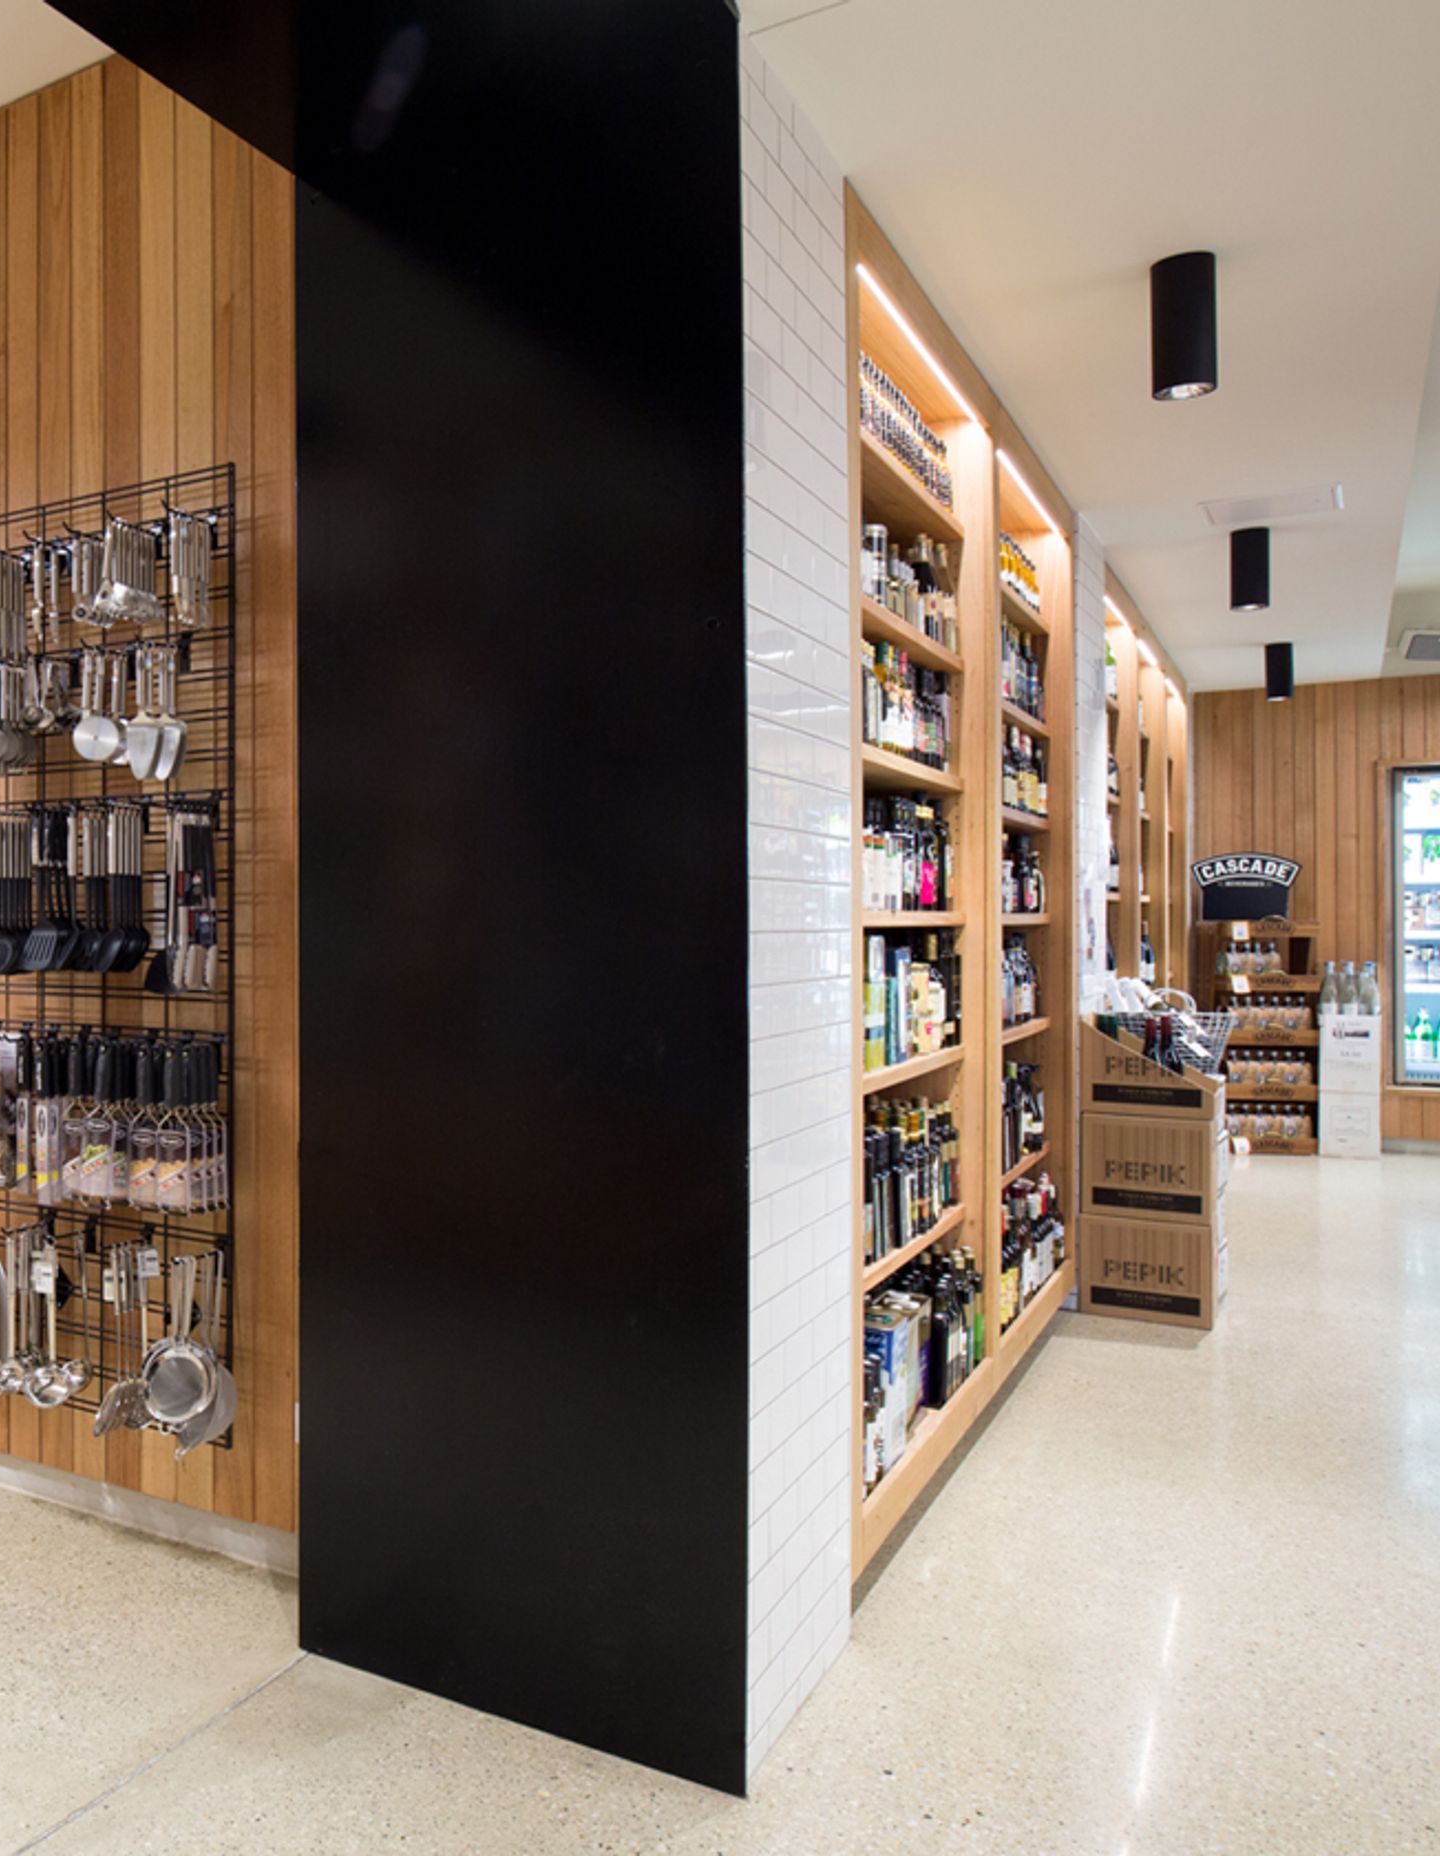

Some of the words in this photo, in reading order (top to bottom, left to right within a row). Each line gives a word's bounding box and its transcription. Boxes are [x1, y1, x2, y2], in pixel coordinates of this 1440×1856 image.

[1201, 859, 1292, 879] CASCADE
[1105, 1160, 1185, 1184] PEPIK
[1104, 1259, 1184, 1285] PEPIK
